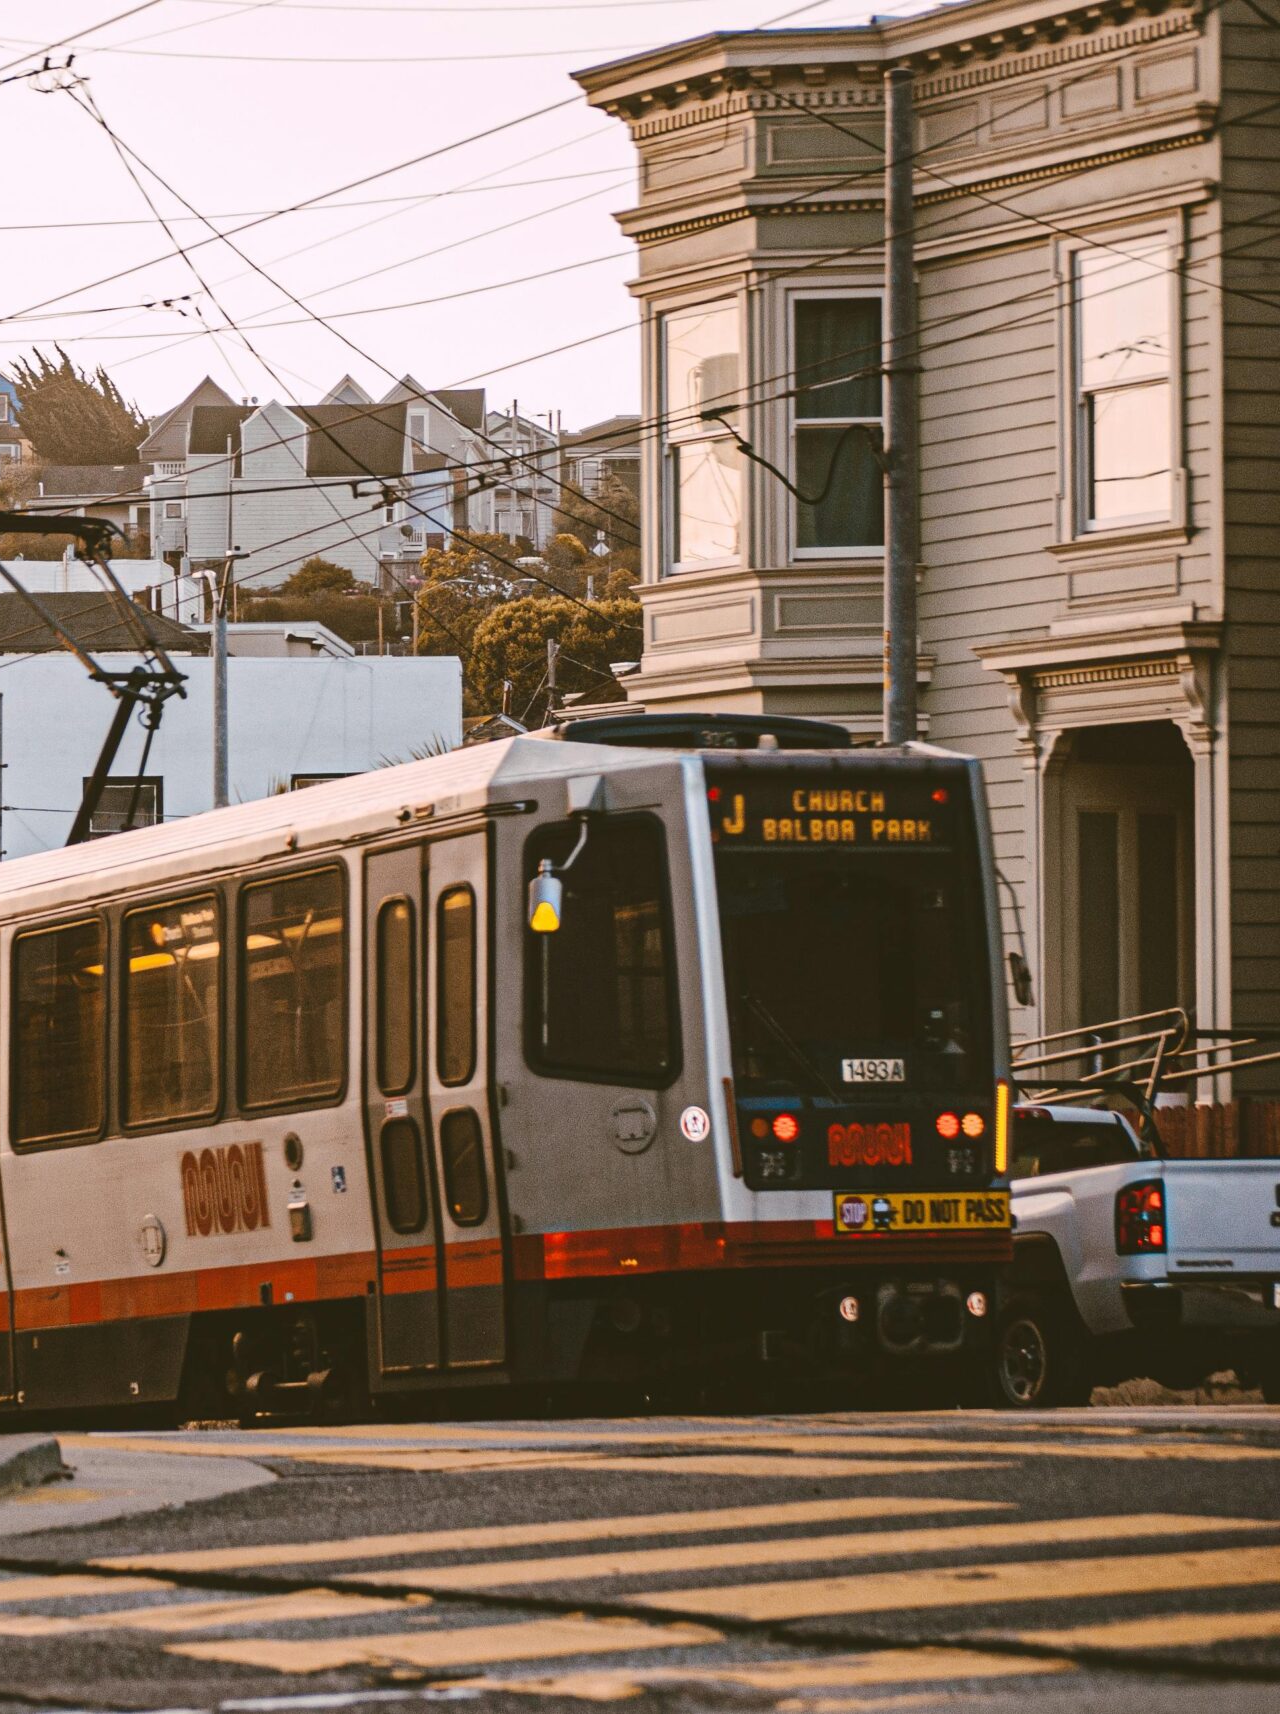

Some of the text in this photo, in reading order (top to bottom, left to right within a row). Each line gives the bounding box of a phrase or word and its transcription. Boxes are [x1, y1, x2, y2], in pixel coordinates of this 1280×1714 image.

[793, 790, 884, 812] CHURCH
[723, 794, 744, 834] J
[763, 818, 931, 841] BALBOA PARK
[847, 1061, 902, 1080] 1493A
[842, 1198, 1004, 1224] STOP DO NOT PASS
